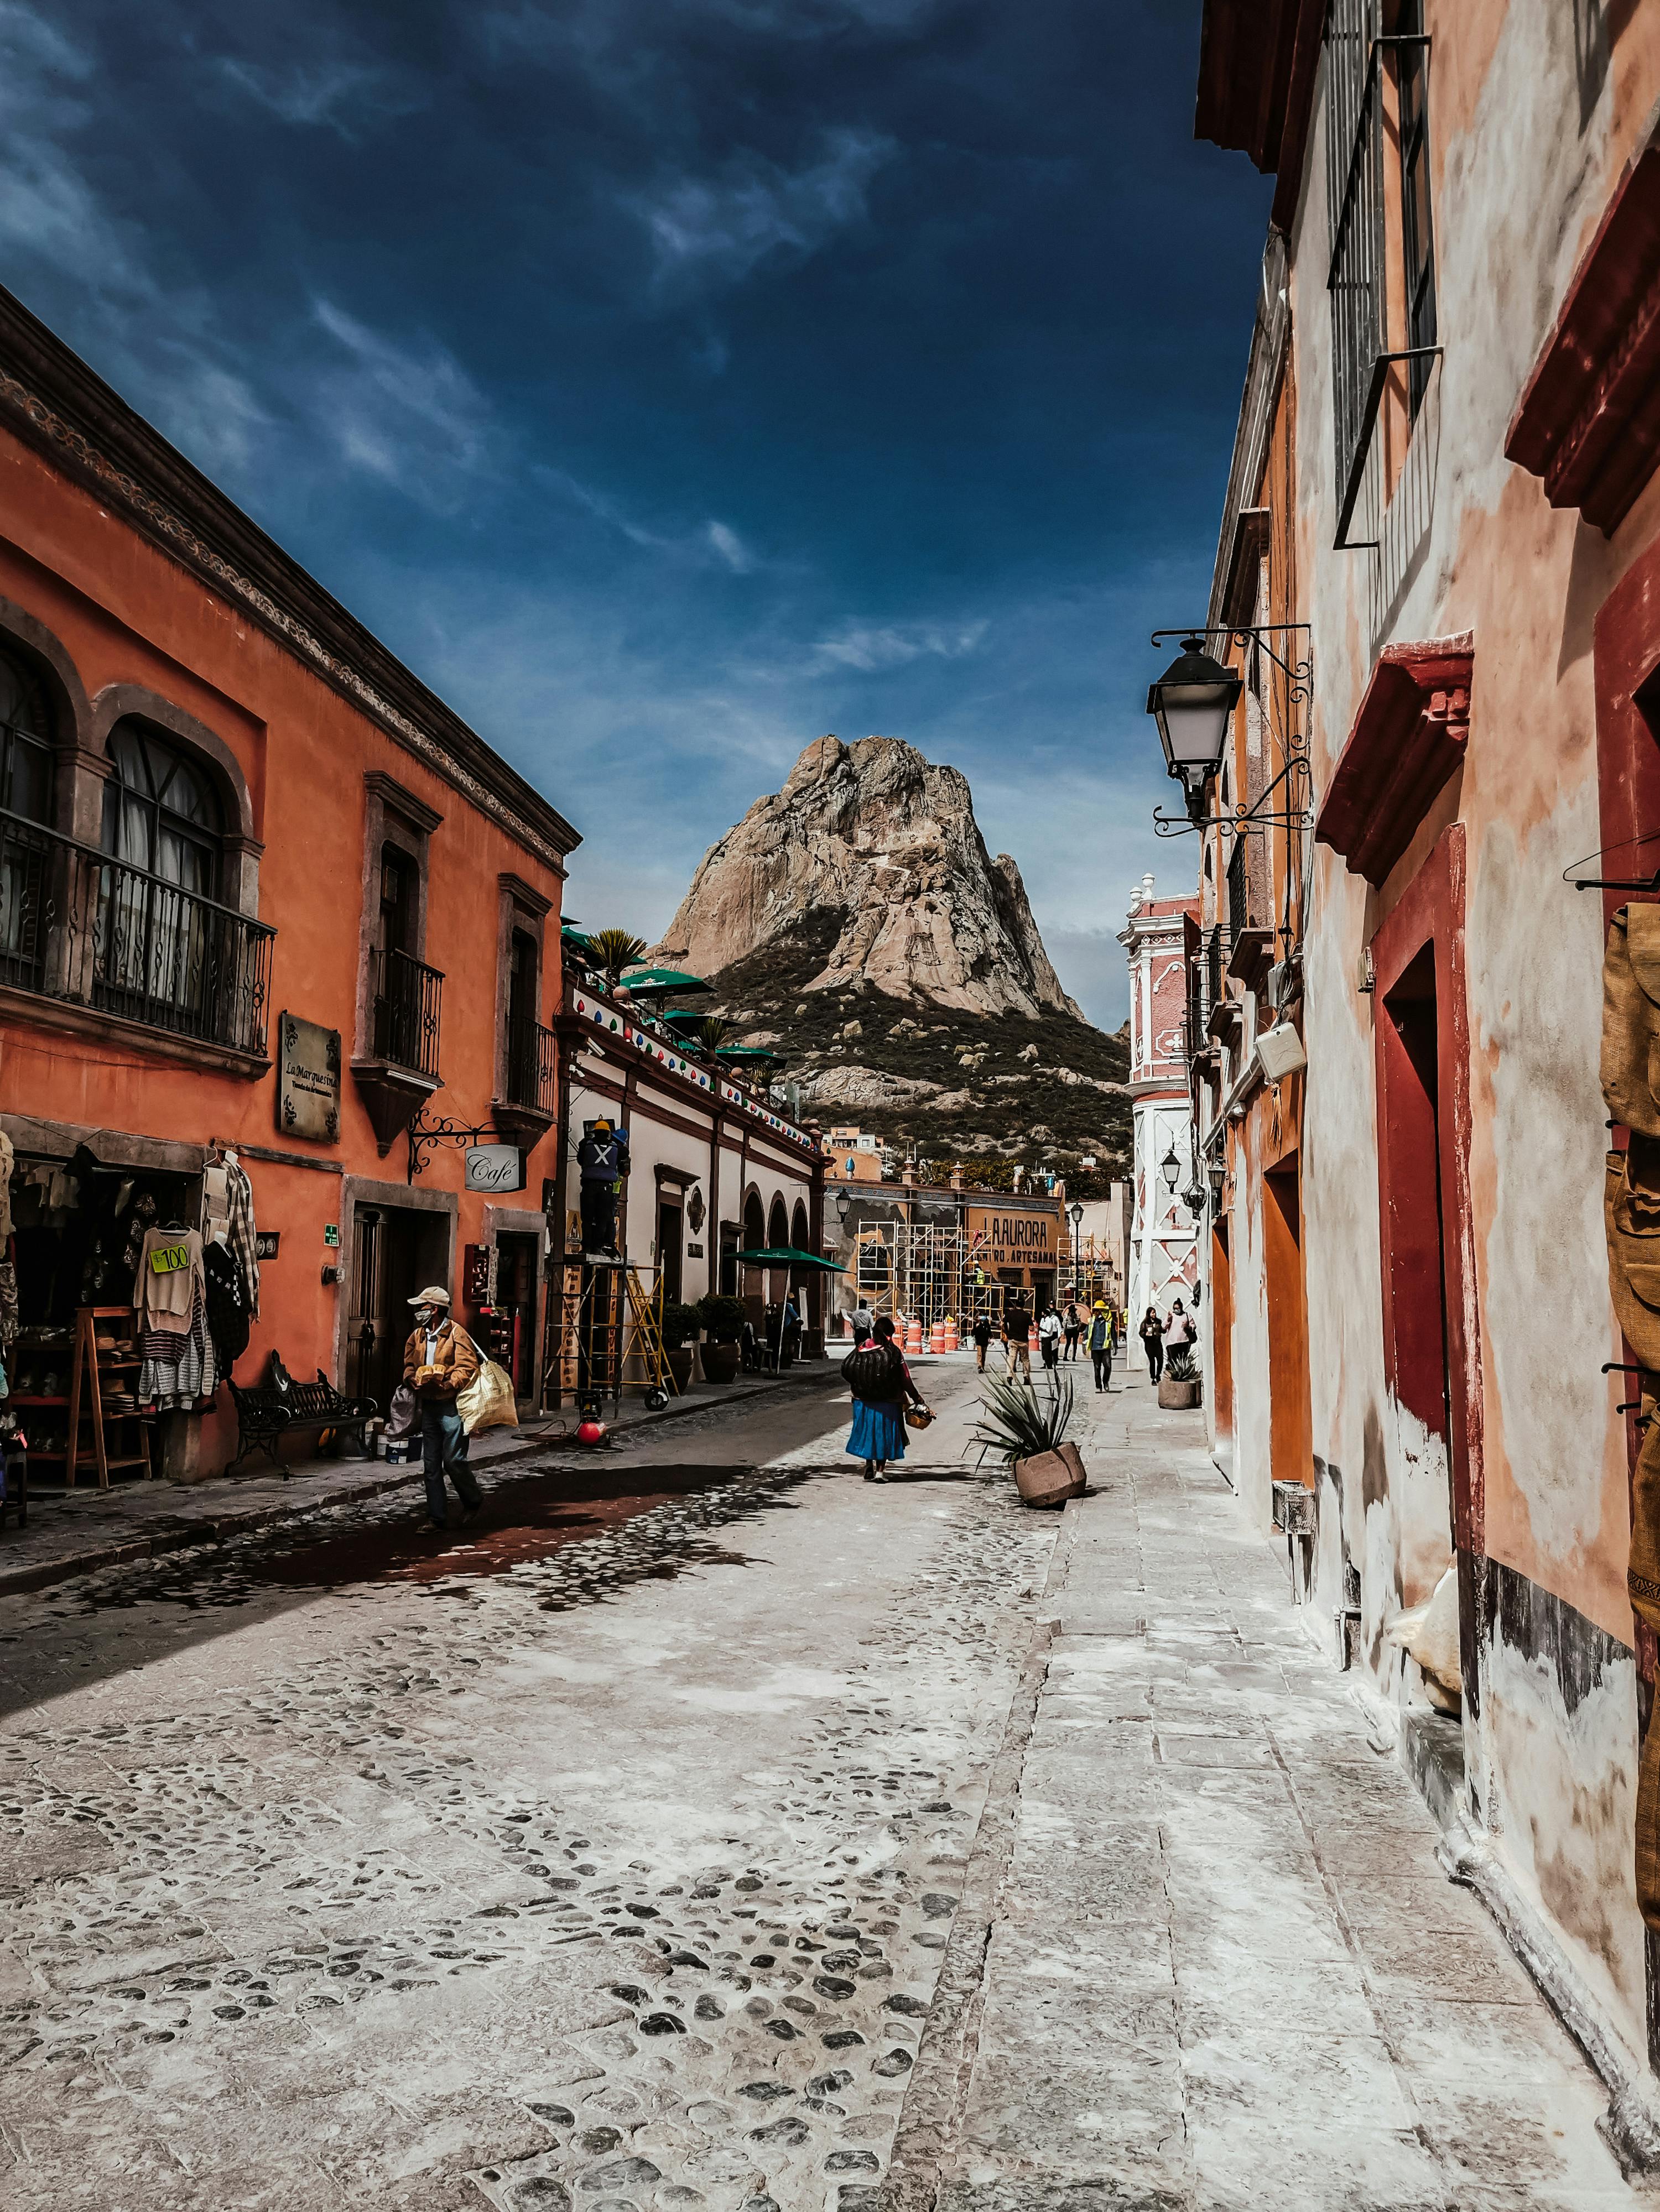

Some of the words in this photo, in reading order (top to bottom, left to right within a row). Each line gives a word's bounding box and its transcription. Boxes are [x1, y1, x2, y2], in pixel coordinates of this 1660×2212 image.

[467, 1154, 517, 1188] Café
[153, 1246, 188, 1270] $100
[1011, 1249, 1058, 1264] ARTESANAL
